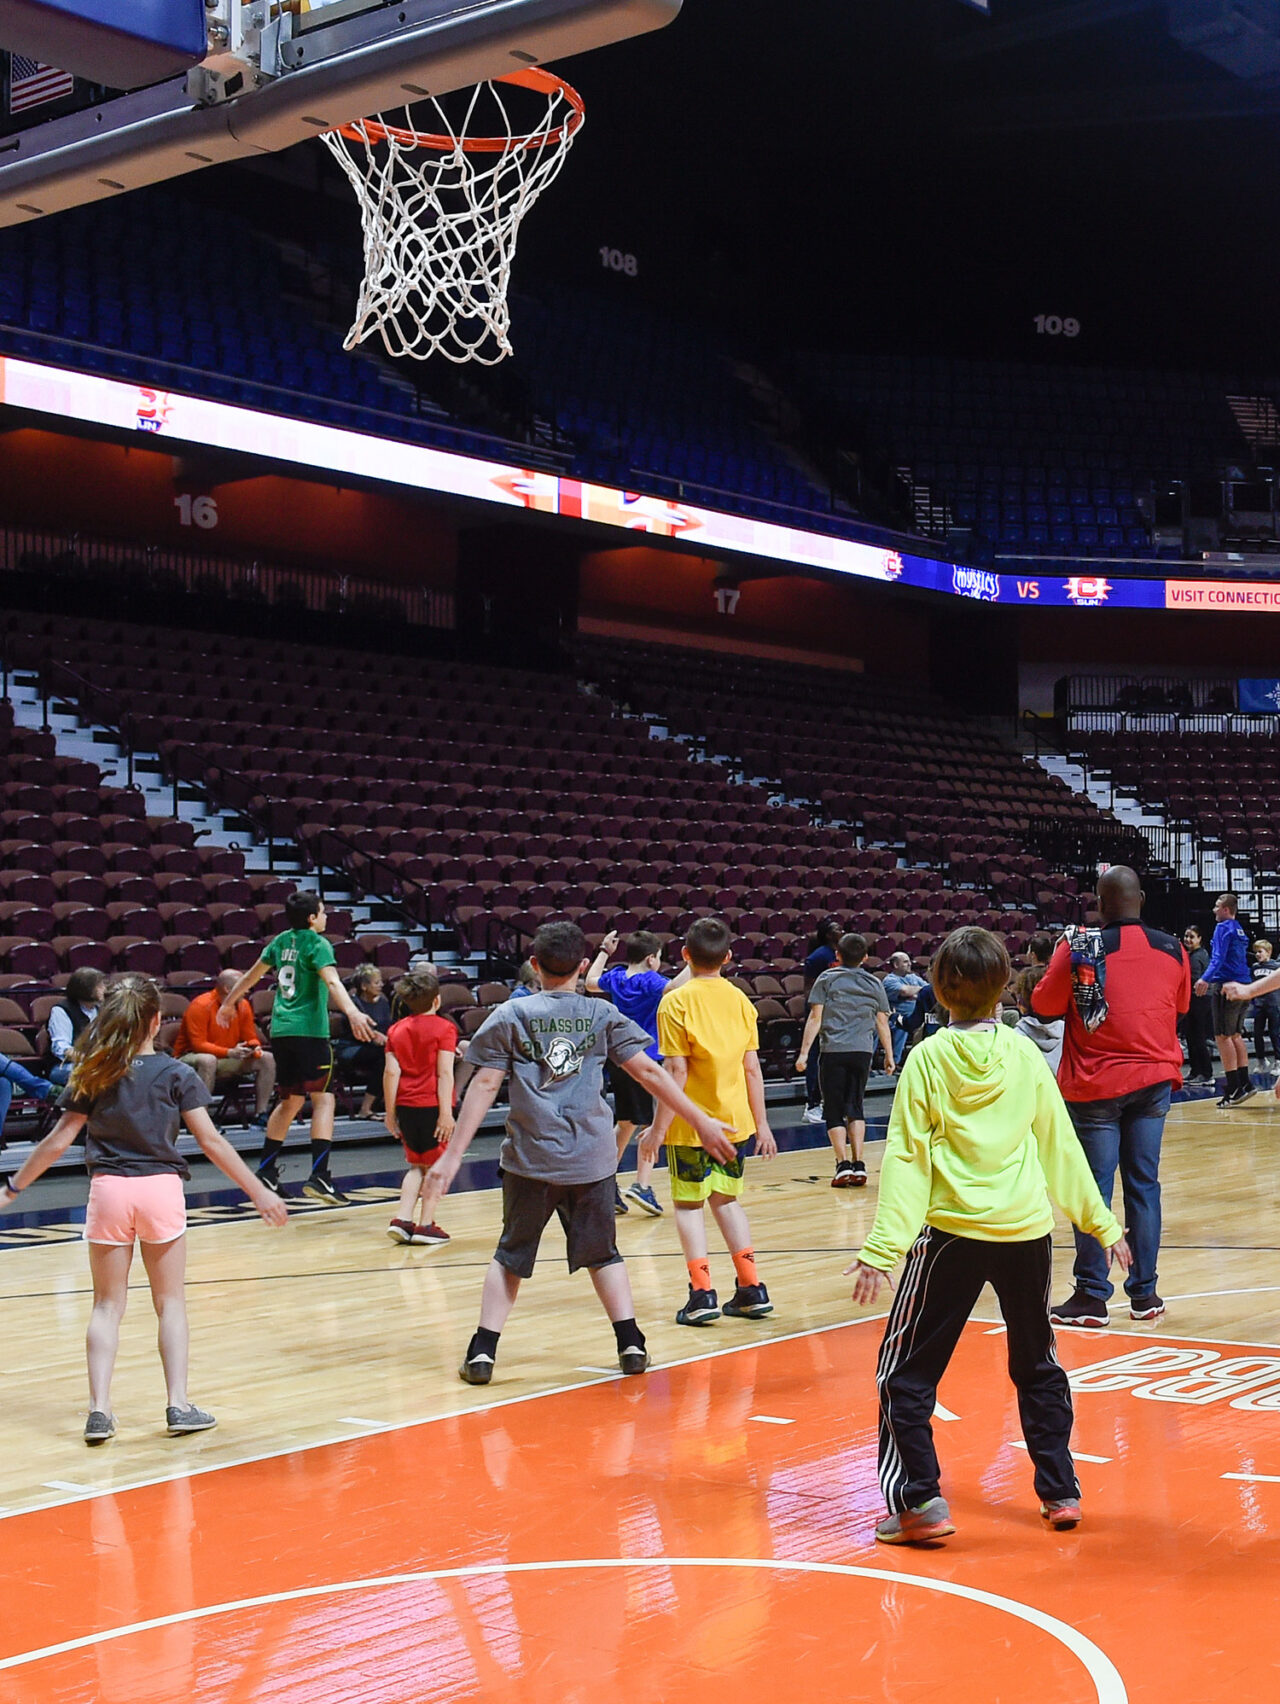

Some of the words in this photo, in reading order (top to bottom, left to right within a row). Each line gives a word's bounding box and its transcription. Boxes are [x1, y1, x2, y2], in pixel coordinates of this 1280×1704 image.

[598, 245, 638, 277] 108
[1033, 314, 1080, 338] 109
[174, 493, 219, 529] 16
[713, 588, 741, 615] 17
[1017, 581, 1040, 599] VS
[1172, 589, 1205, 603] VISIT
[529, 1017, 573, 1033] CLASS
[575, 1017, 593, 1032] OF
